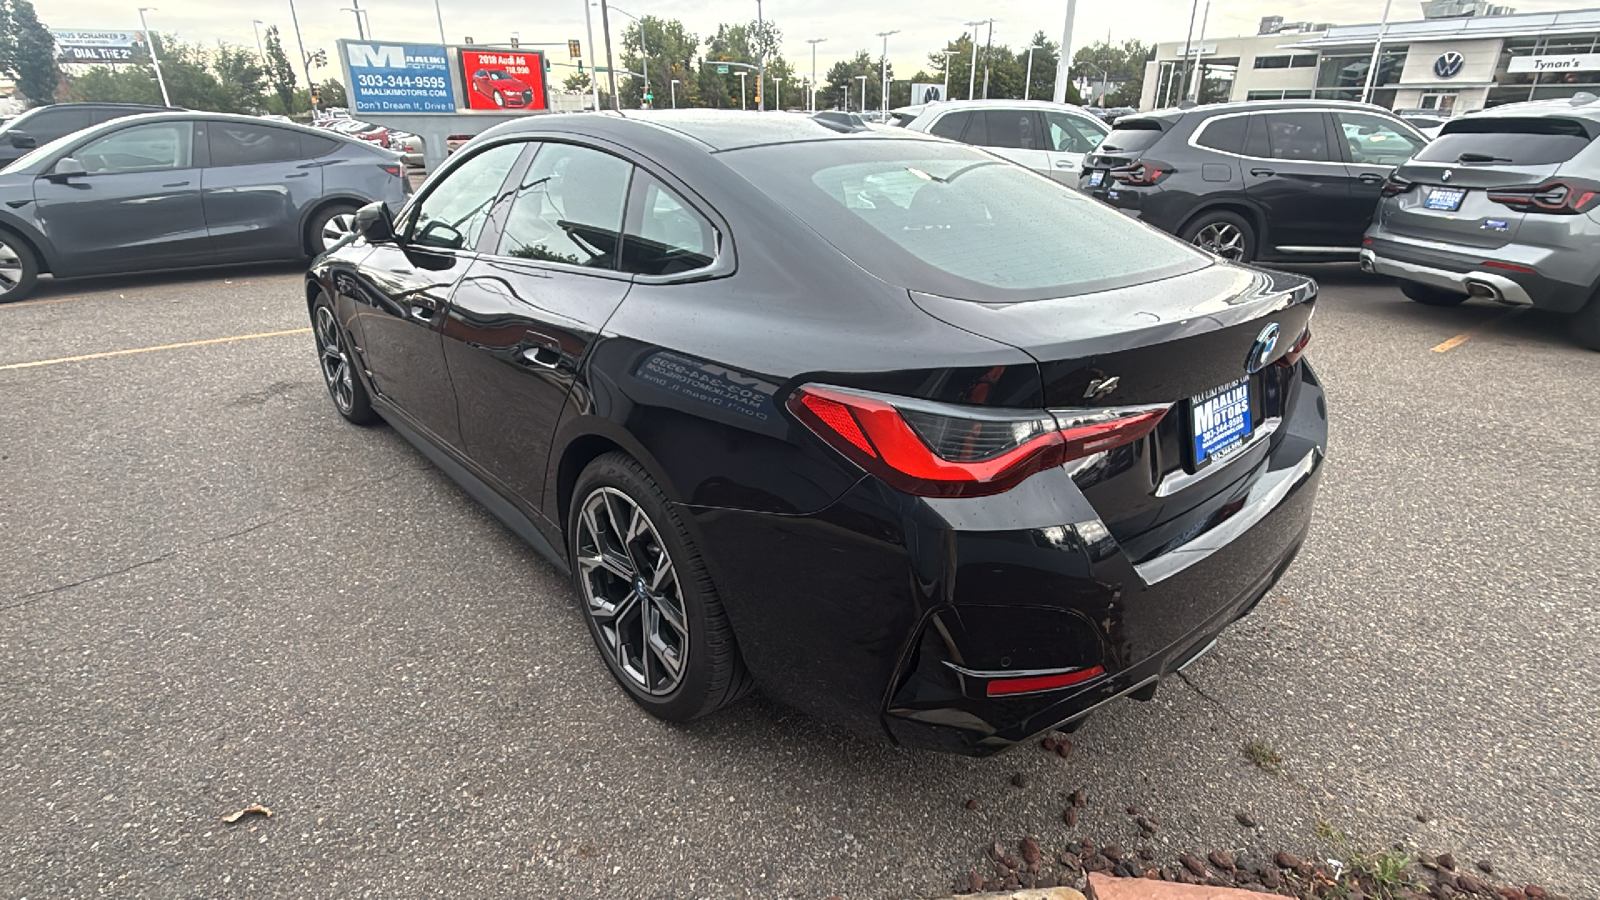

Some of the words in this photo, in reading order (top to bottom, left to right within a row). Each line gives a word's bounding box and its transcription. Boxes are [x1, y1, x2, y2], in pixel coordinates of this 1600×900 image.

[73, 48, 98, 59] DIAL
[478, 54, 497, 64] 2018
[498, 54, 515, 66] Audi
[516, 56, 526, 66] A6
[1534, 57, 1580, 71] Tynan's
[406, 62, 446, 71] MOTORS
[358, 74, 446, 89] 303-344-9595
[360, 88, 448, 98] MAALIKIMOTORS.COM
[356, 101, 381, 110] Don't
[383, 101, 411, 110] Dream
[424, 102, 446, 110] Drive
[1083, 376, 1120, 398] i4
